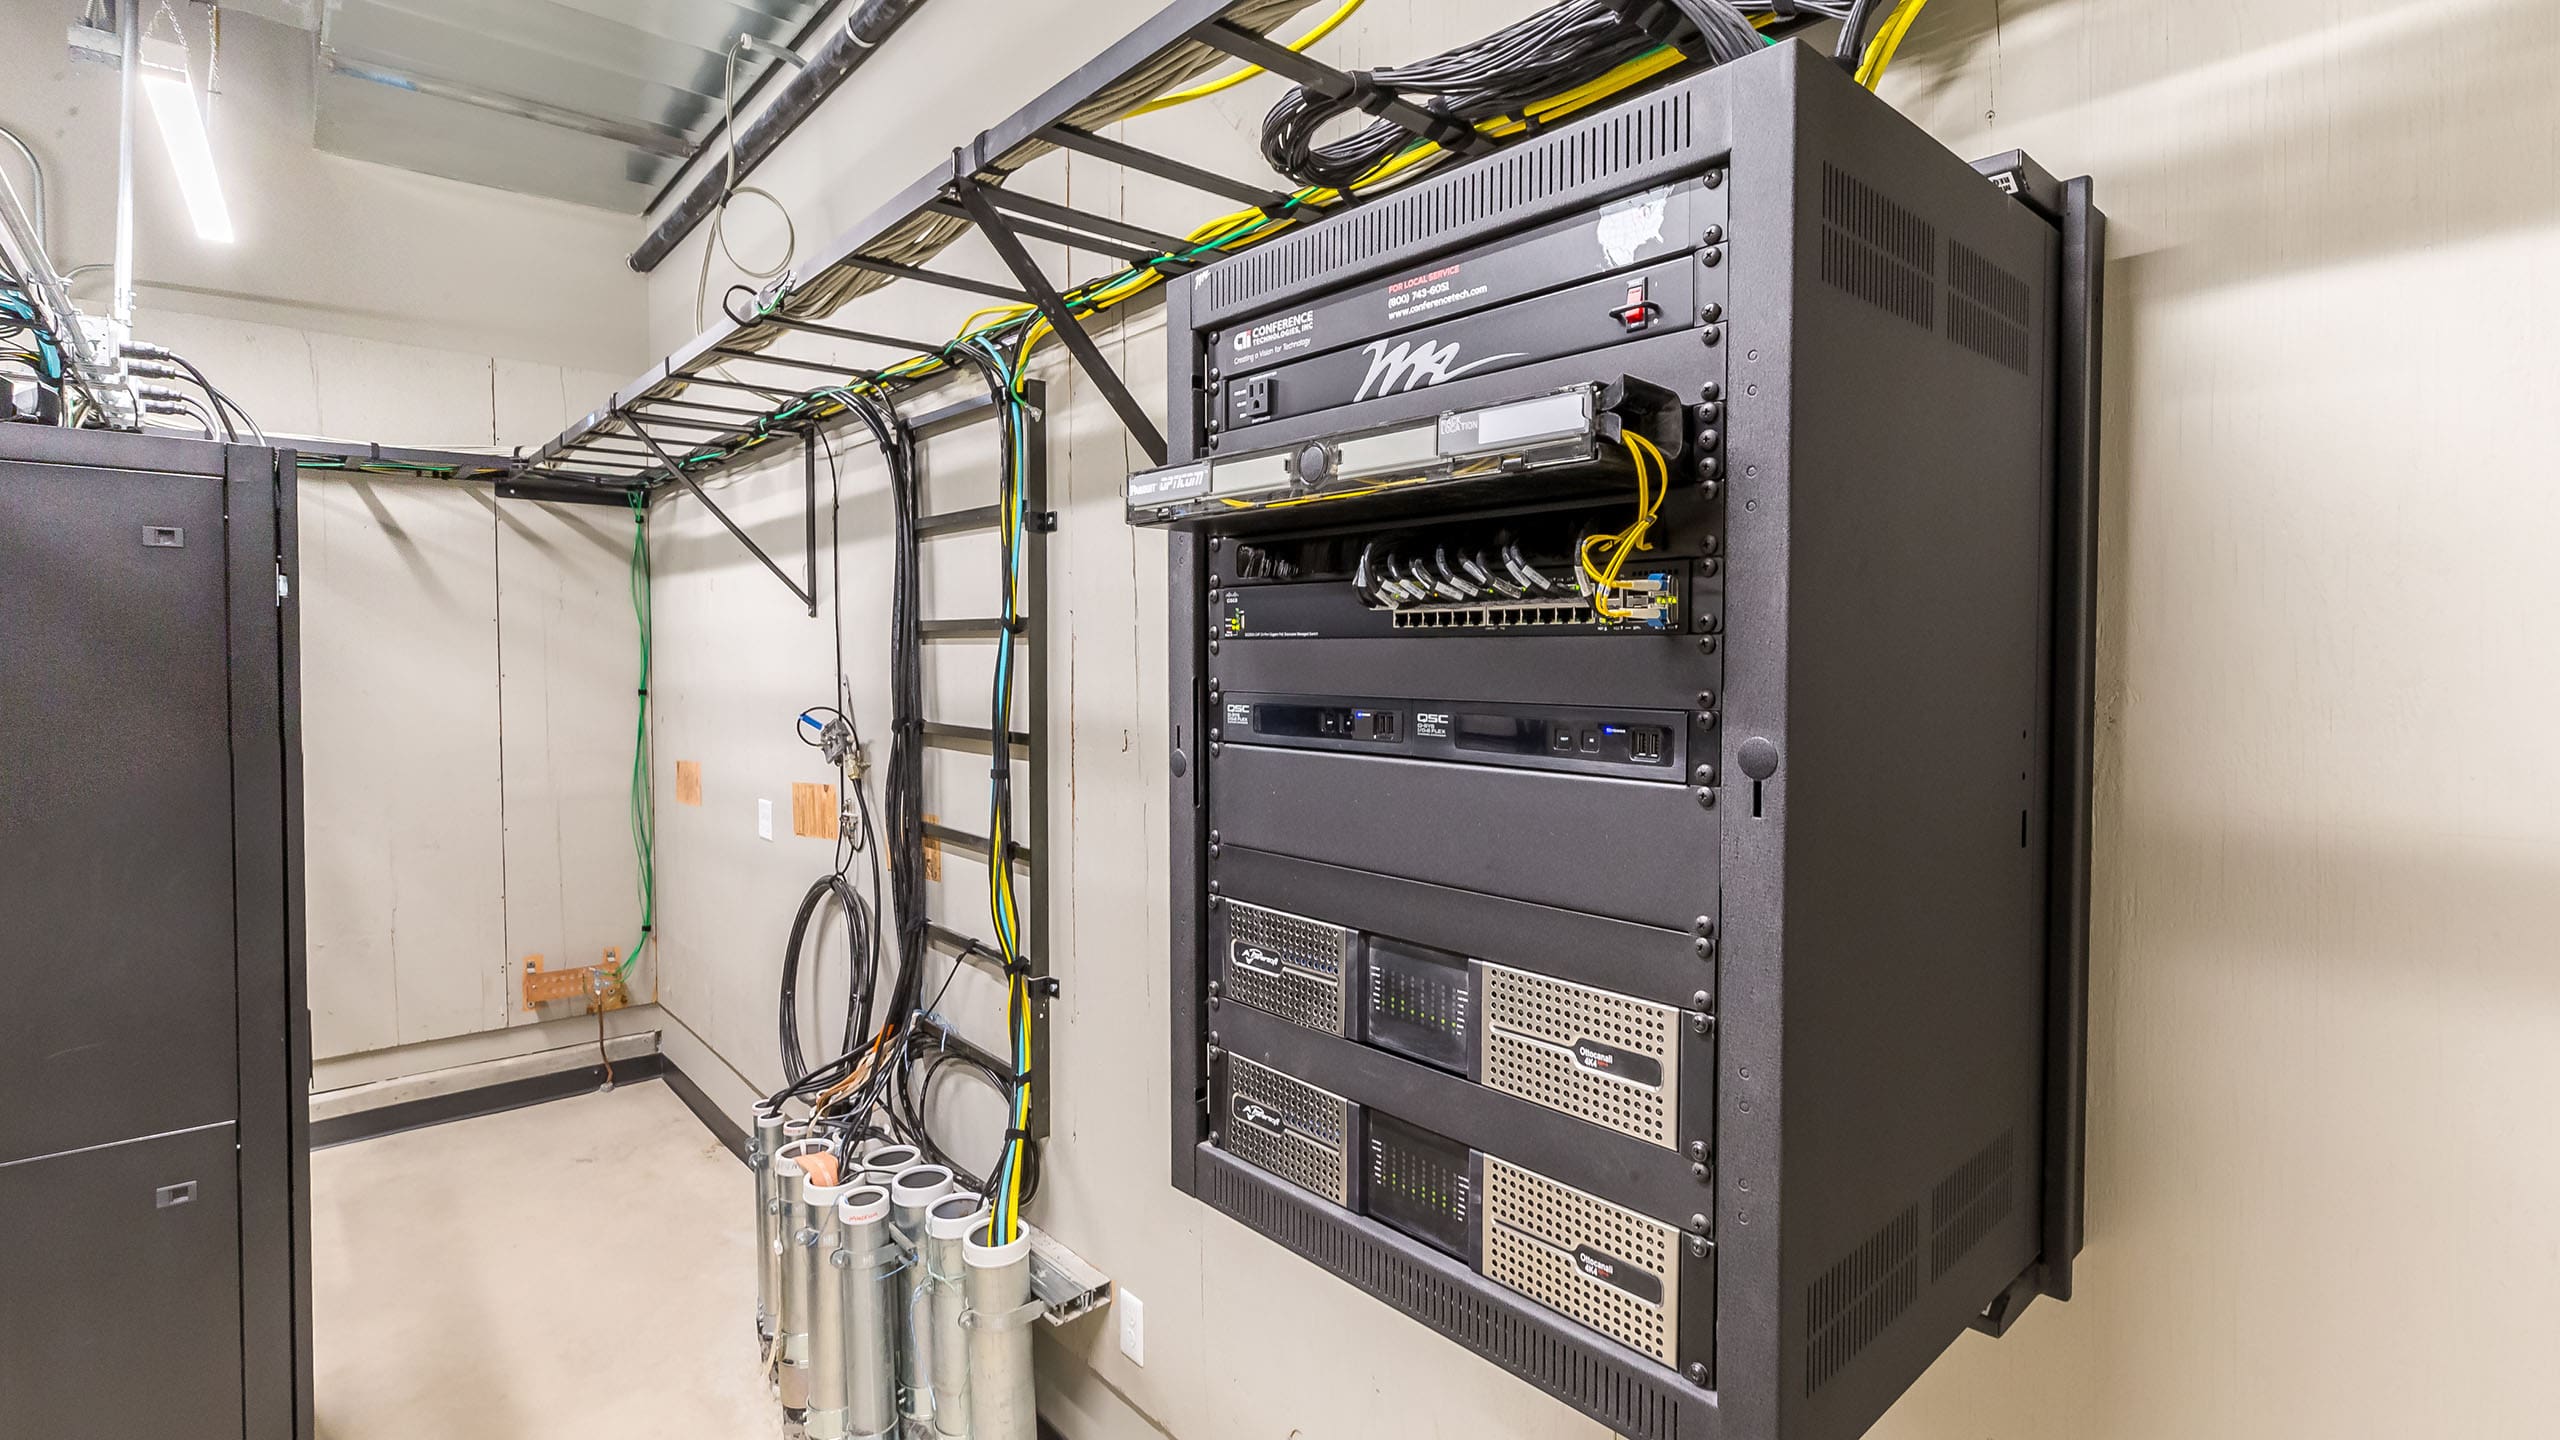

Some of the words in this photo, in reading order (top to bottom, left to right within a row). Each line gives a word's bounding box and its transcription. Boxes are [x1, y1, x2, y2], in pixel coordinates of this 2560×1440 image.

[1388, 282, 1404, 294] FOR
[1404, 275, 1428, 290] LOCAL
[1428, 264, 1460, 281] SERVICE
[1388, 293, 1410, 308] (800)
[1388, 285, 1488, 320] www.conferencetech.com
[1252, 310, 1314, 338] CONFERENCE
[1301, 321, 1314, 332] INC
[1227, 704, 1250, 713] QSC
[1417, 713, 1449, 724] QSC
